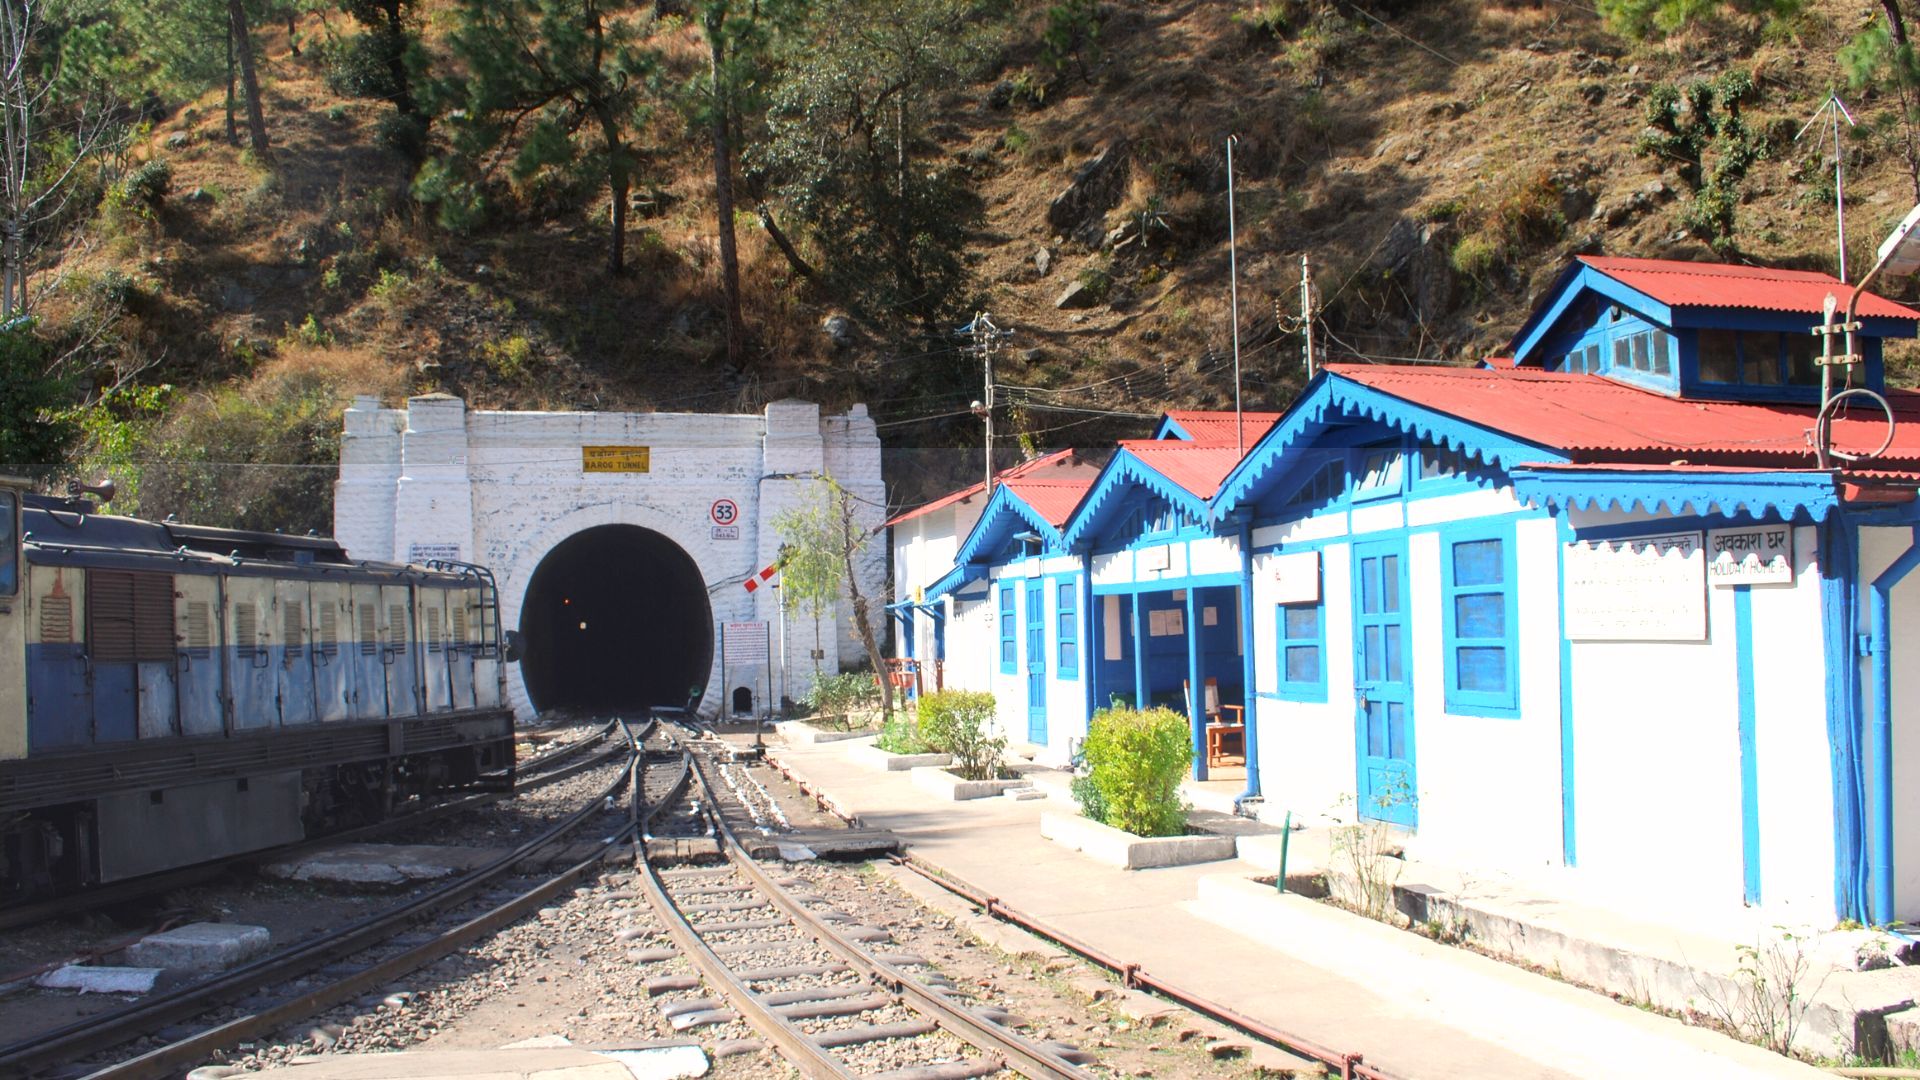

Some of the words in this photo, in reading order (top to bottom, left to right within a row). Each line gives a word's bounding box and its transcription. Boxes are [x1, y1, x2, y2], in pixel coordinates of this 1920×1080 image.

[617, 461, 646, 469] TUNNEL
[716, 505, 733, 520] 33
[1713, 533, 1762, 552] अवकाश
[1766, 531, 1786, 549] घर
[1710, 561, 1746, 576] HOLIDAY
[1750, 560, 1775, 574] HOME
